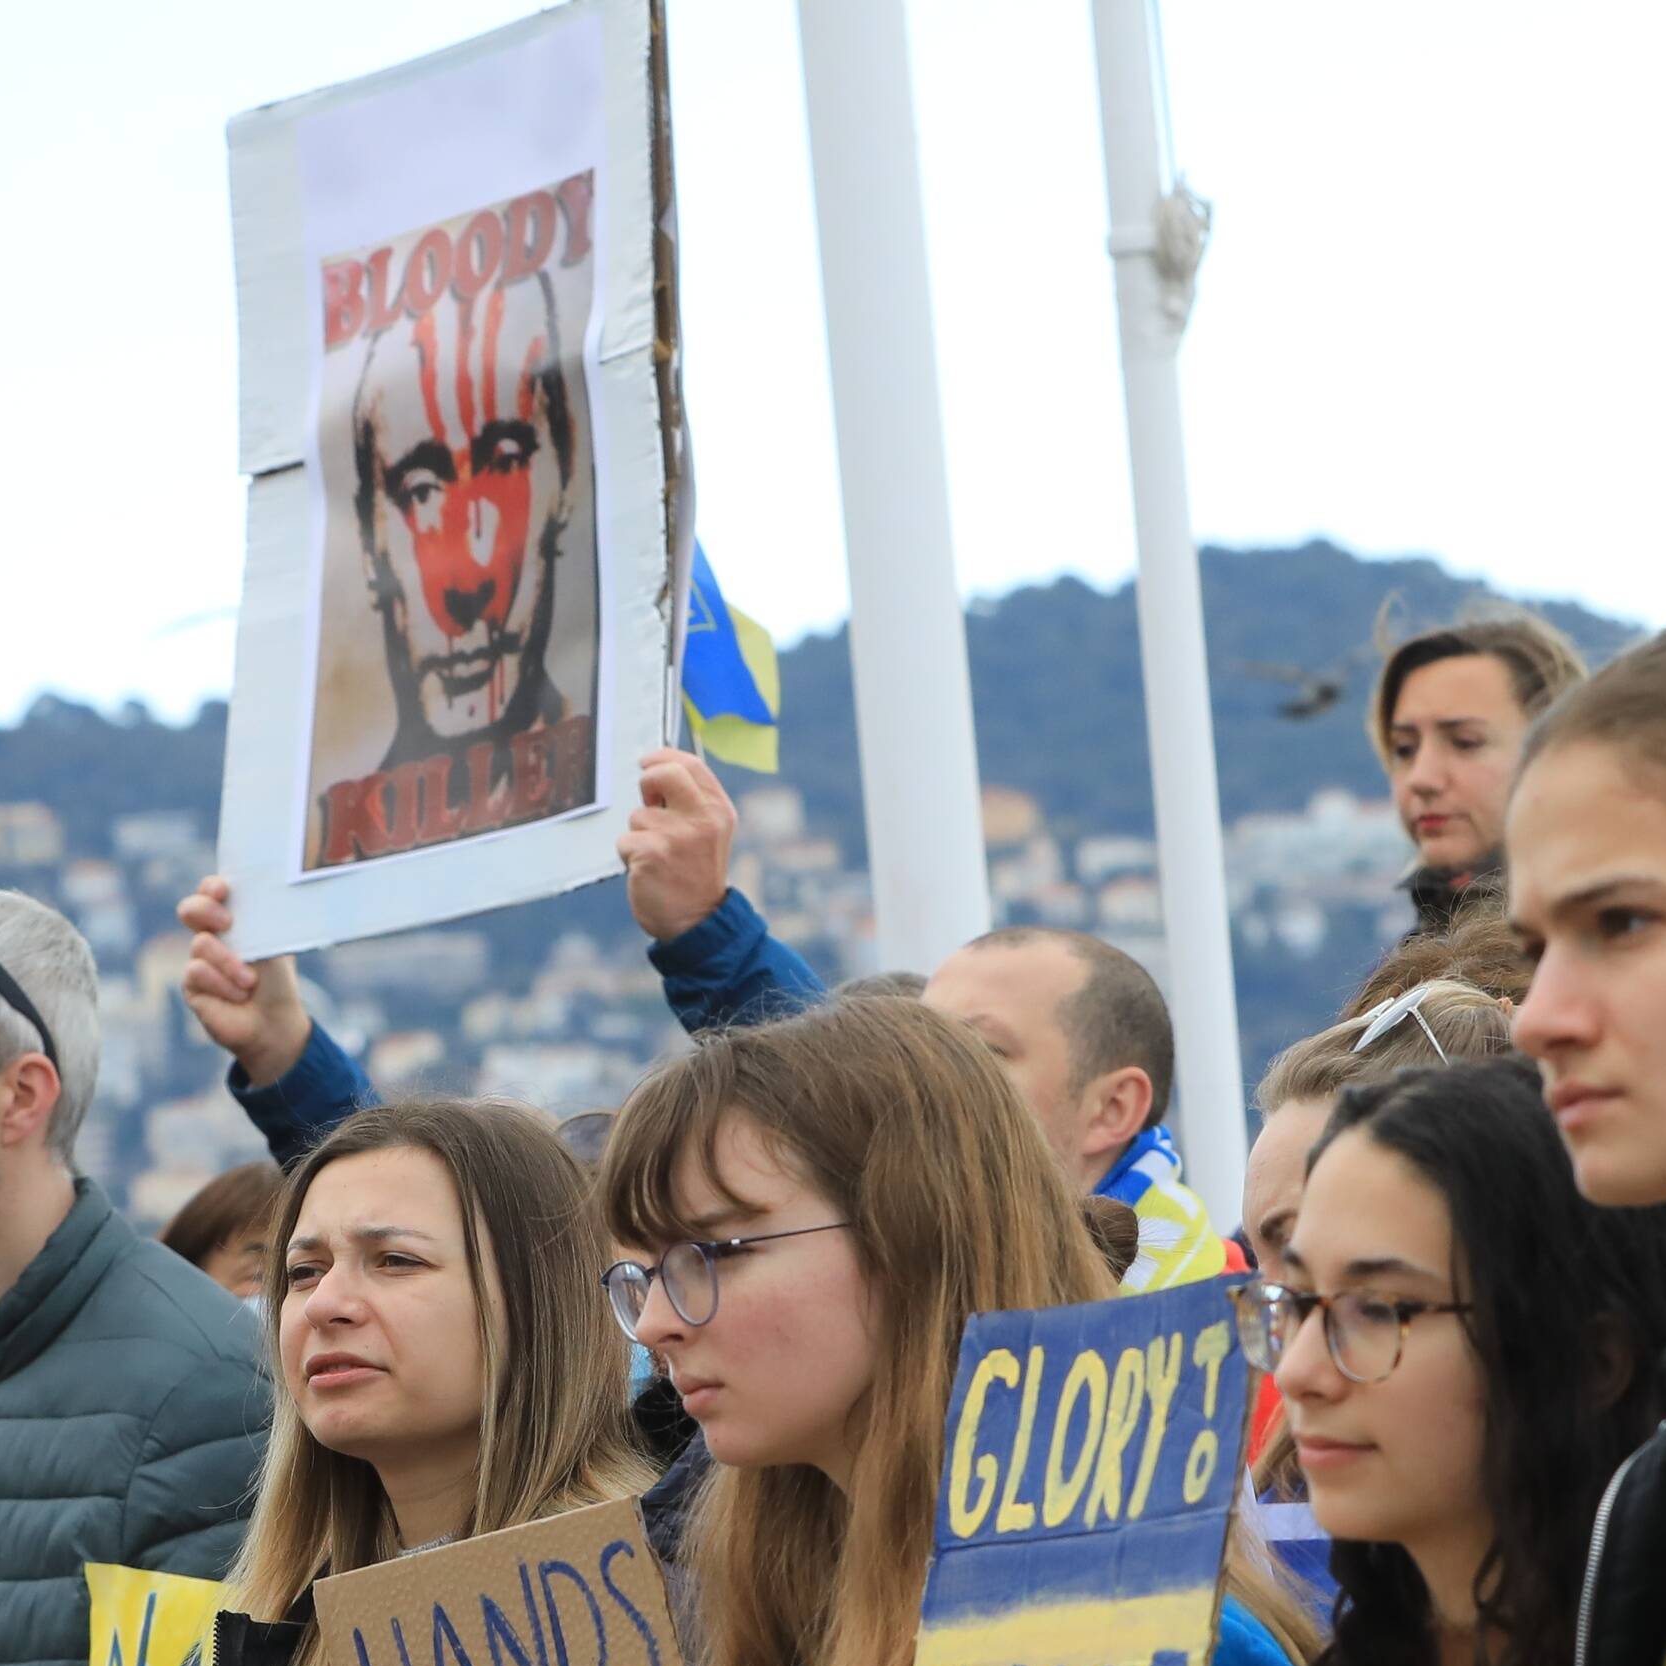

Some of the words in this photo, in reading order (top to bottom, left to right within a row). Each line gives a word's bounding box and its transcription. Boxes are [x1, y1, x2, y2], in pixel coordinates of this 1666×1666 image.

[323, 169, 595, 351] BLOODY
[322, 714, 594, 864] KILLER
[947, 1330, 1183, 1540] GLORY
